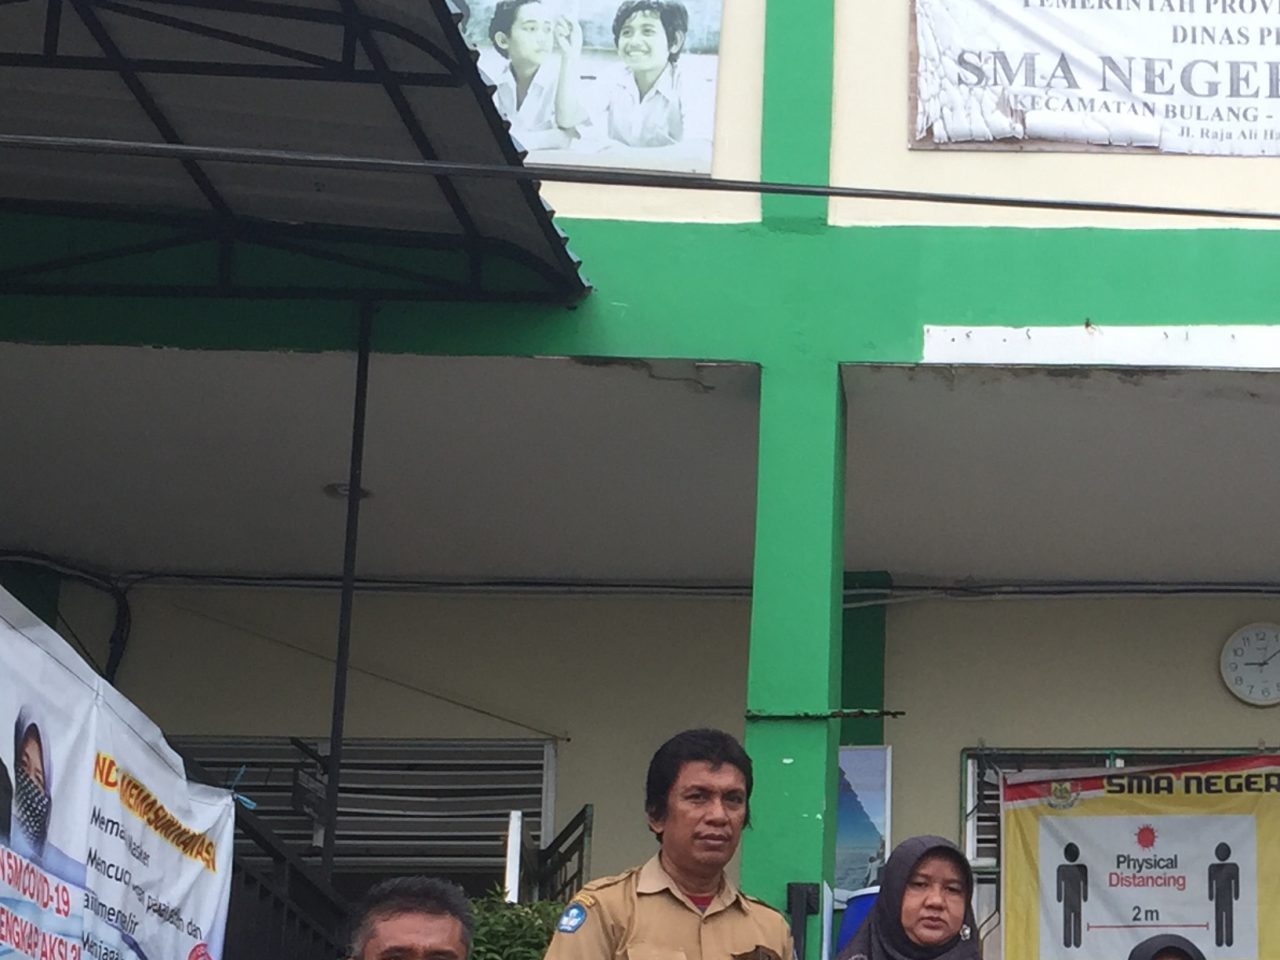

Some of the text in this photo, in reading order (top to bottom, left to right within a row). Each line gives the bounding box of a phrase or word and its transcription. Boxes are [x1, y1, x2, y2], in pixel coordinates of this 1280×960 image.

[1172, 25, 1250, 46] DINAS
[957, 49, 1081, 90] SMA
[1014, 94, 1156, 118] KECAMATAN
[1165, 104, 1258, 122] BULANG
[1200, 127, 1233, 142] Raja
[1106, 774, 1174, 795] SMA
[1116, 853, 1179, 874] Physical
[1108, 872, 1187, 892] Distancing
[1132, 905, 1160, 922] 2 m
